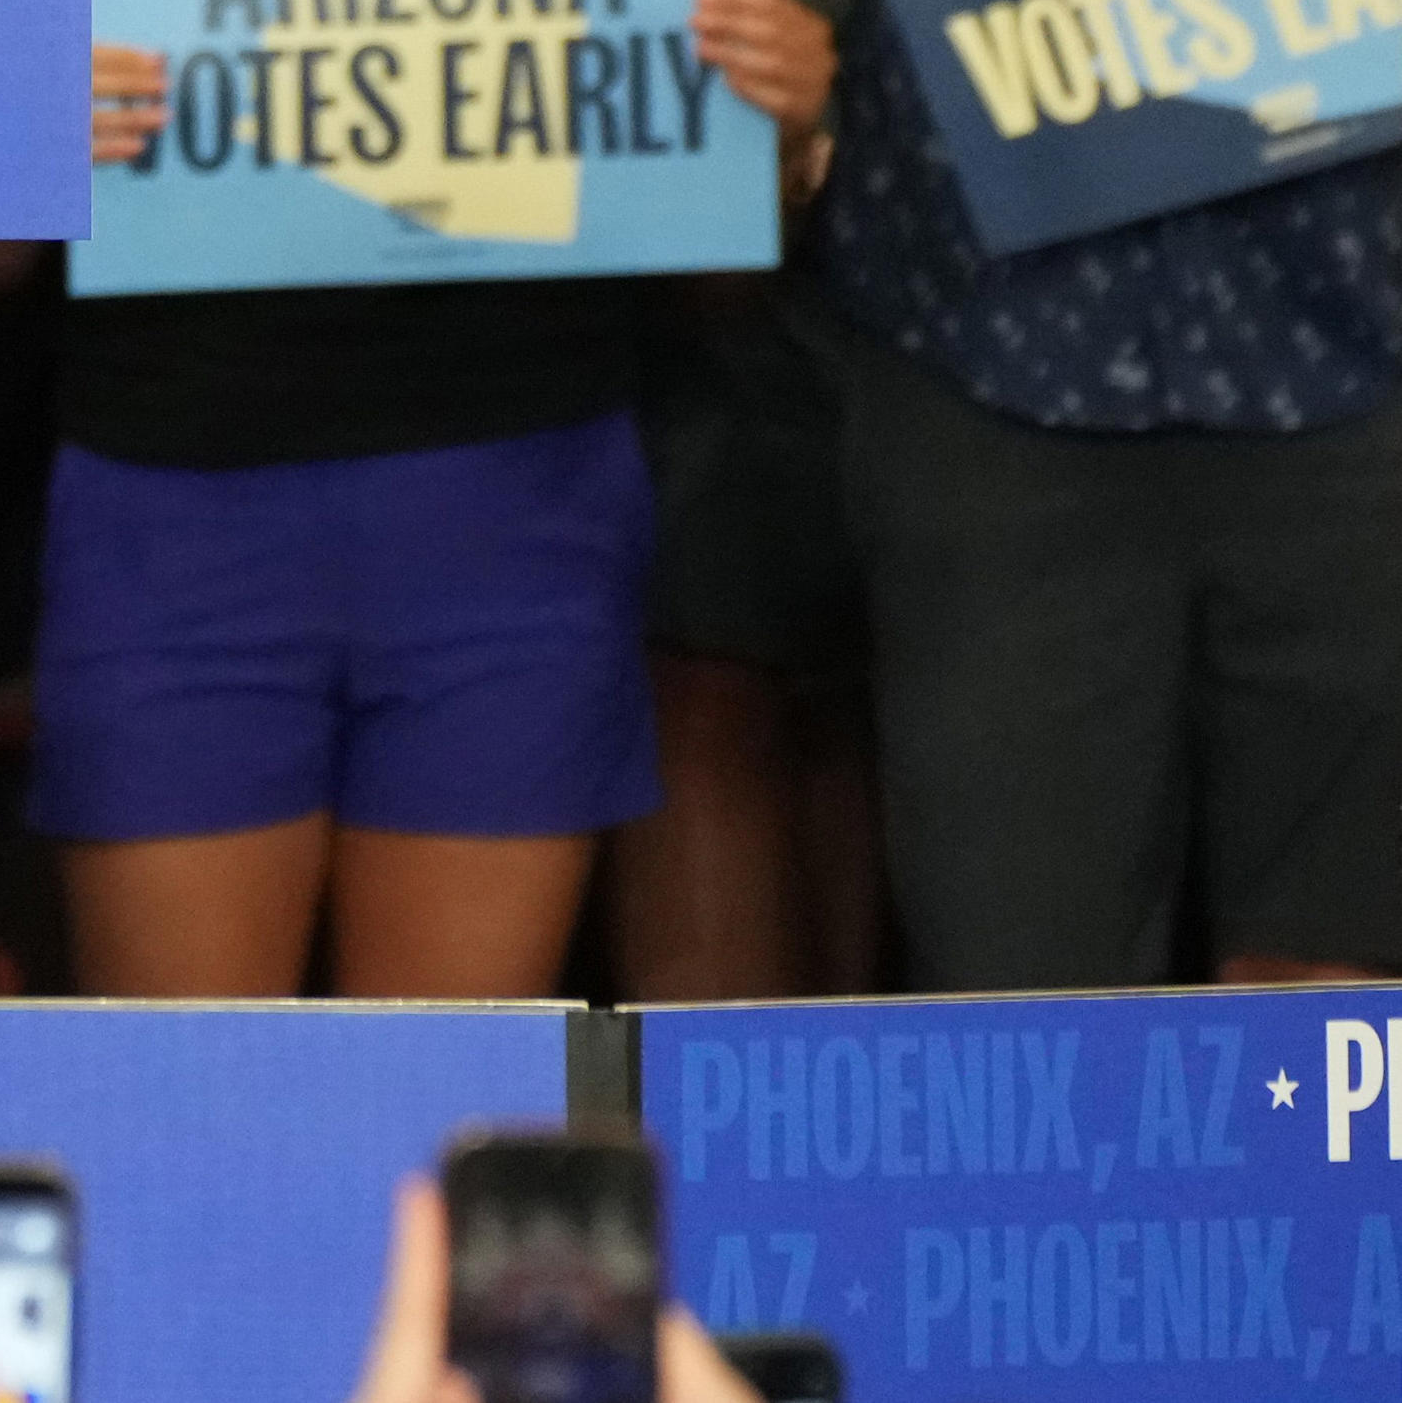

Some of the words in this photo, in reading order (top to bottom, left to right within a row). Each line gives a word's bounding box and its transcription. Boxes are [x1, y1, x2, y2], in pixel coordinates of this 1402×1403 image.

[441, 23, 725, 161] EARLY
[681, 1028, 1119, 1193] PHOENIX,
[1136, 1026, 1246, 1169] AZ
[904, 1215, 1332, 1381] PHOENIX,
